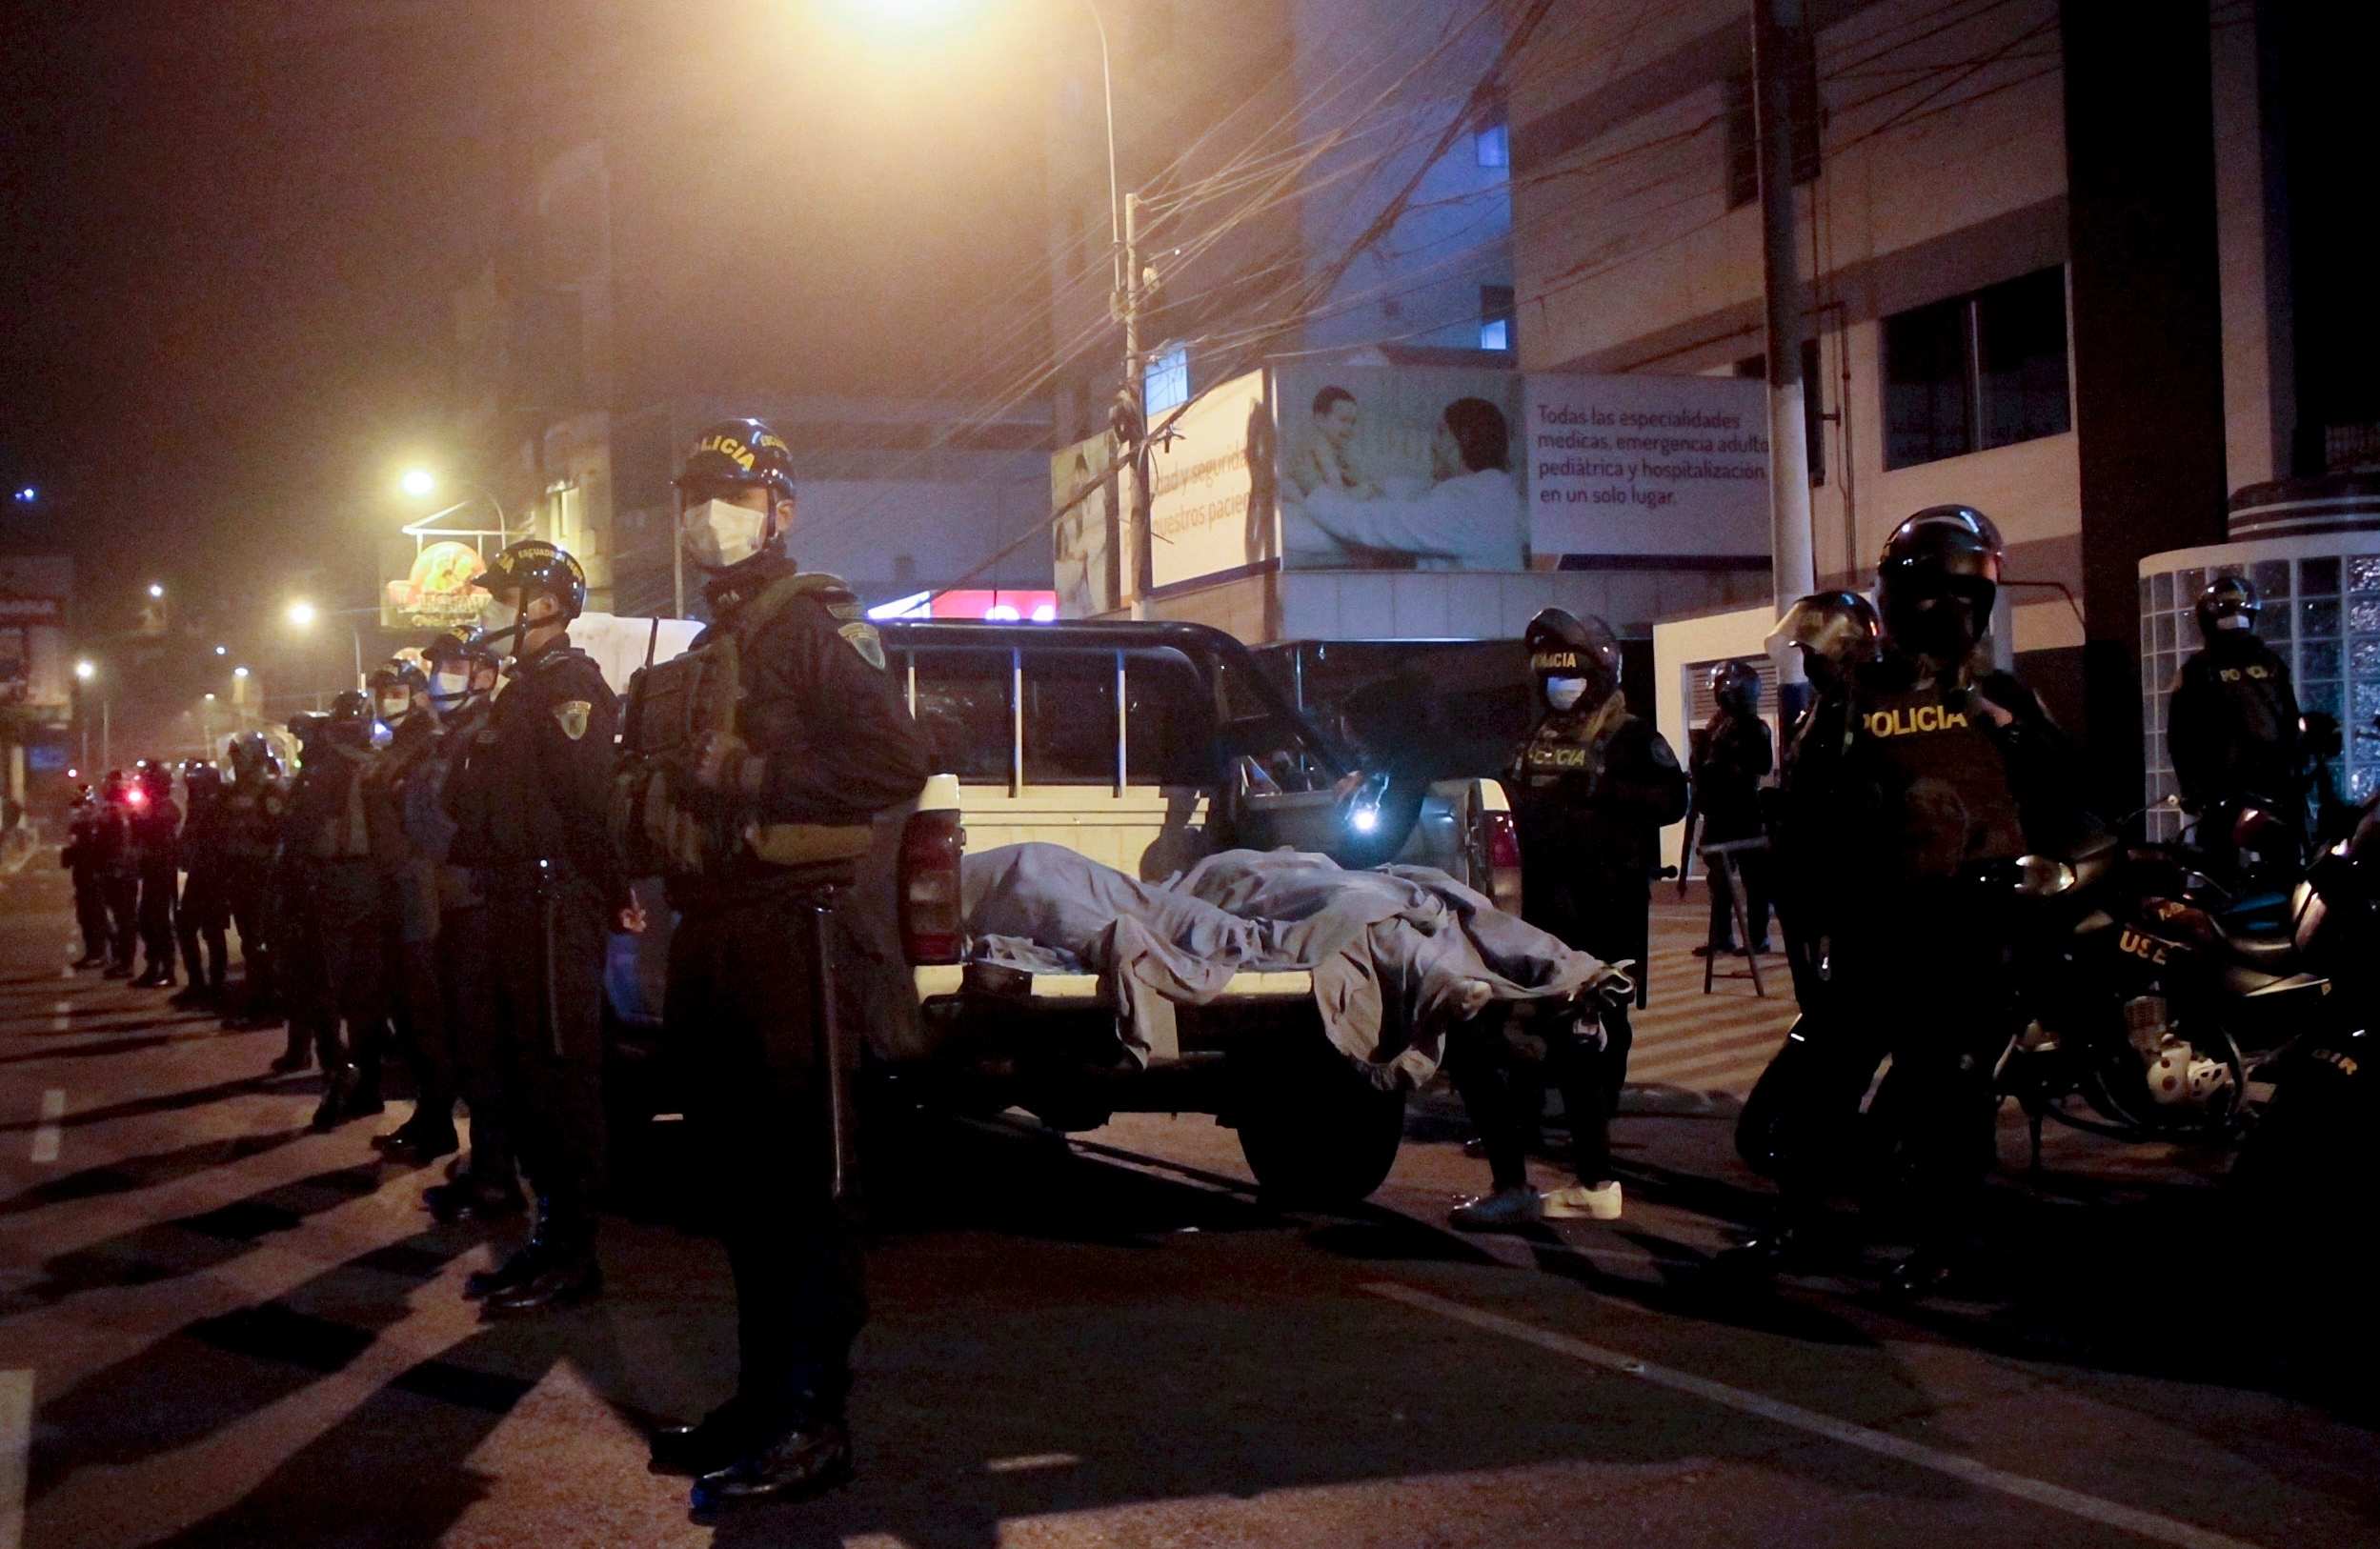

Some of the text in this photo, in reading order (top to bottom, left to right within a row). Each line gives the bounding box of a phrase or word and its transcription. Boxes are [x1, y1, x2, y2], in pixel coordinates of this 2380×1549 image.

[1537, 404, 1740, 430] Todas las especialidades
[1617, 435, 1713, 456] emergencia
[1190, 442, 1247, 489] segurida
[1539, 457, 1765, 482] pediátrica y hospitalización
[1540, 489, 1562, 504] en
[1566, 490, 1588, 504] un
[1592, 486, 1627, 505] solo
[1208, 488, 1250, 533] pacien
